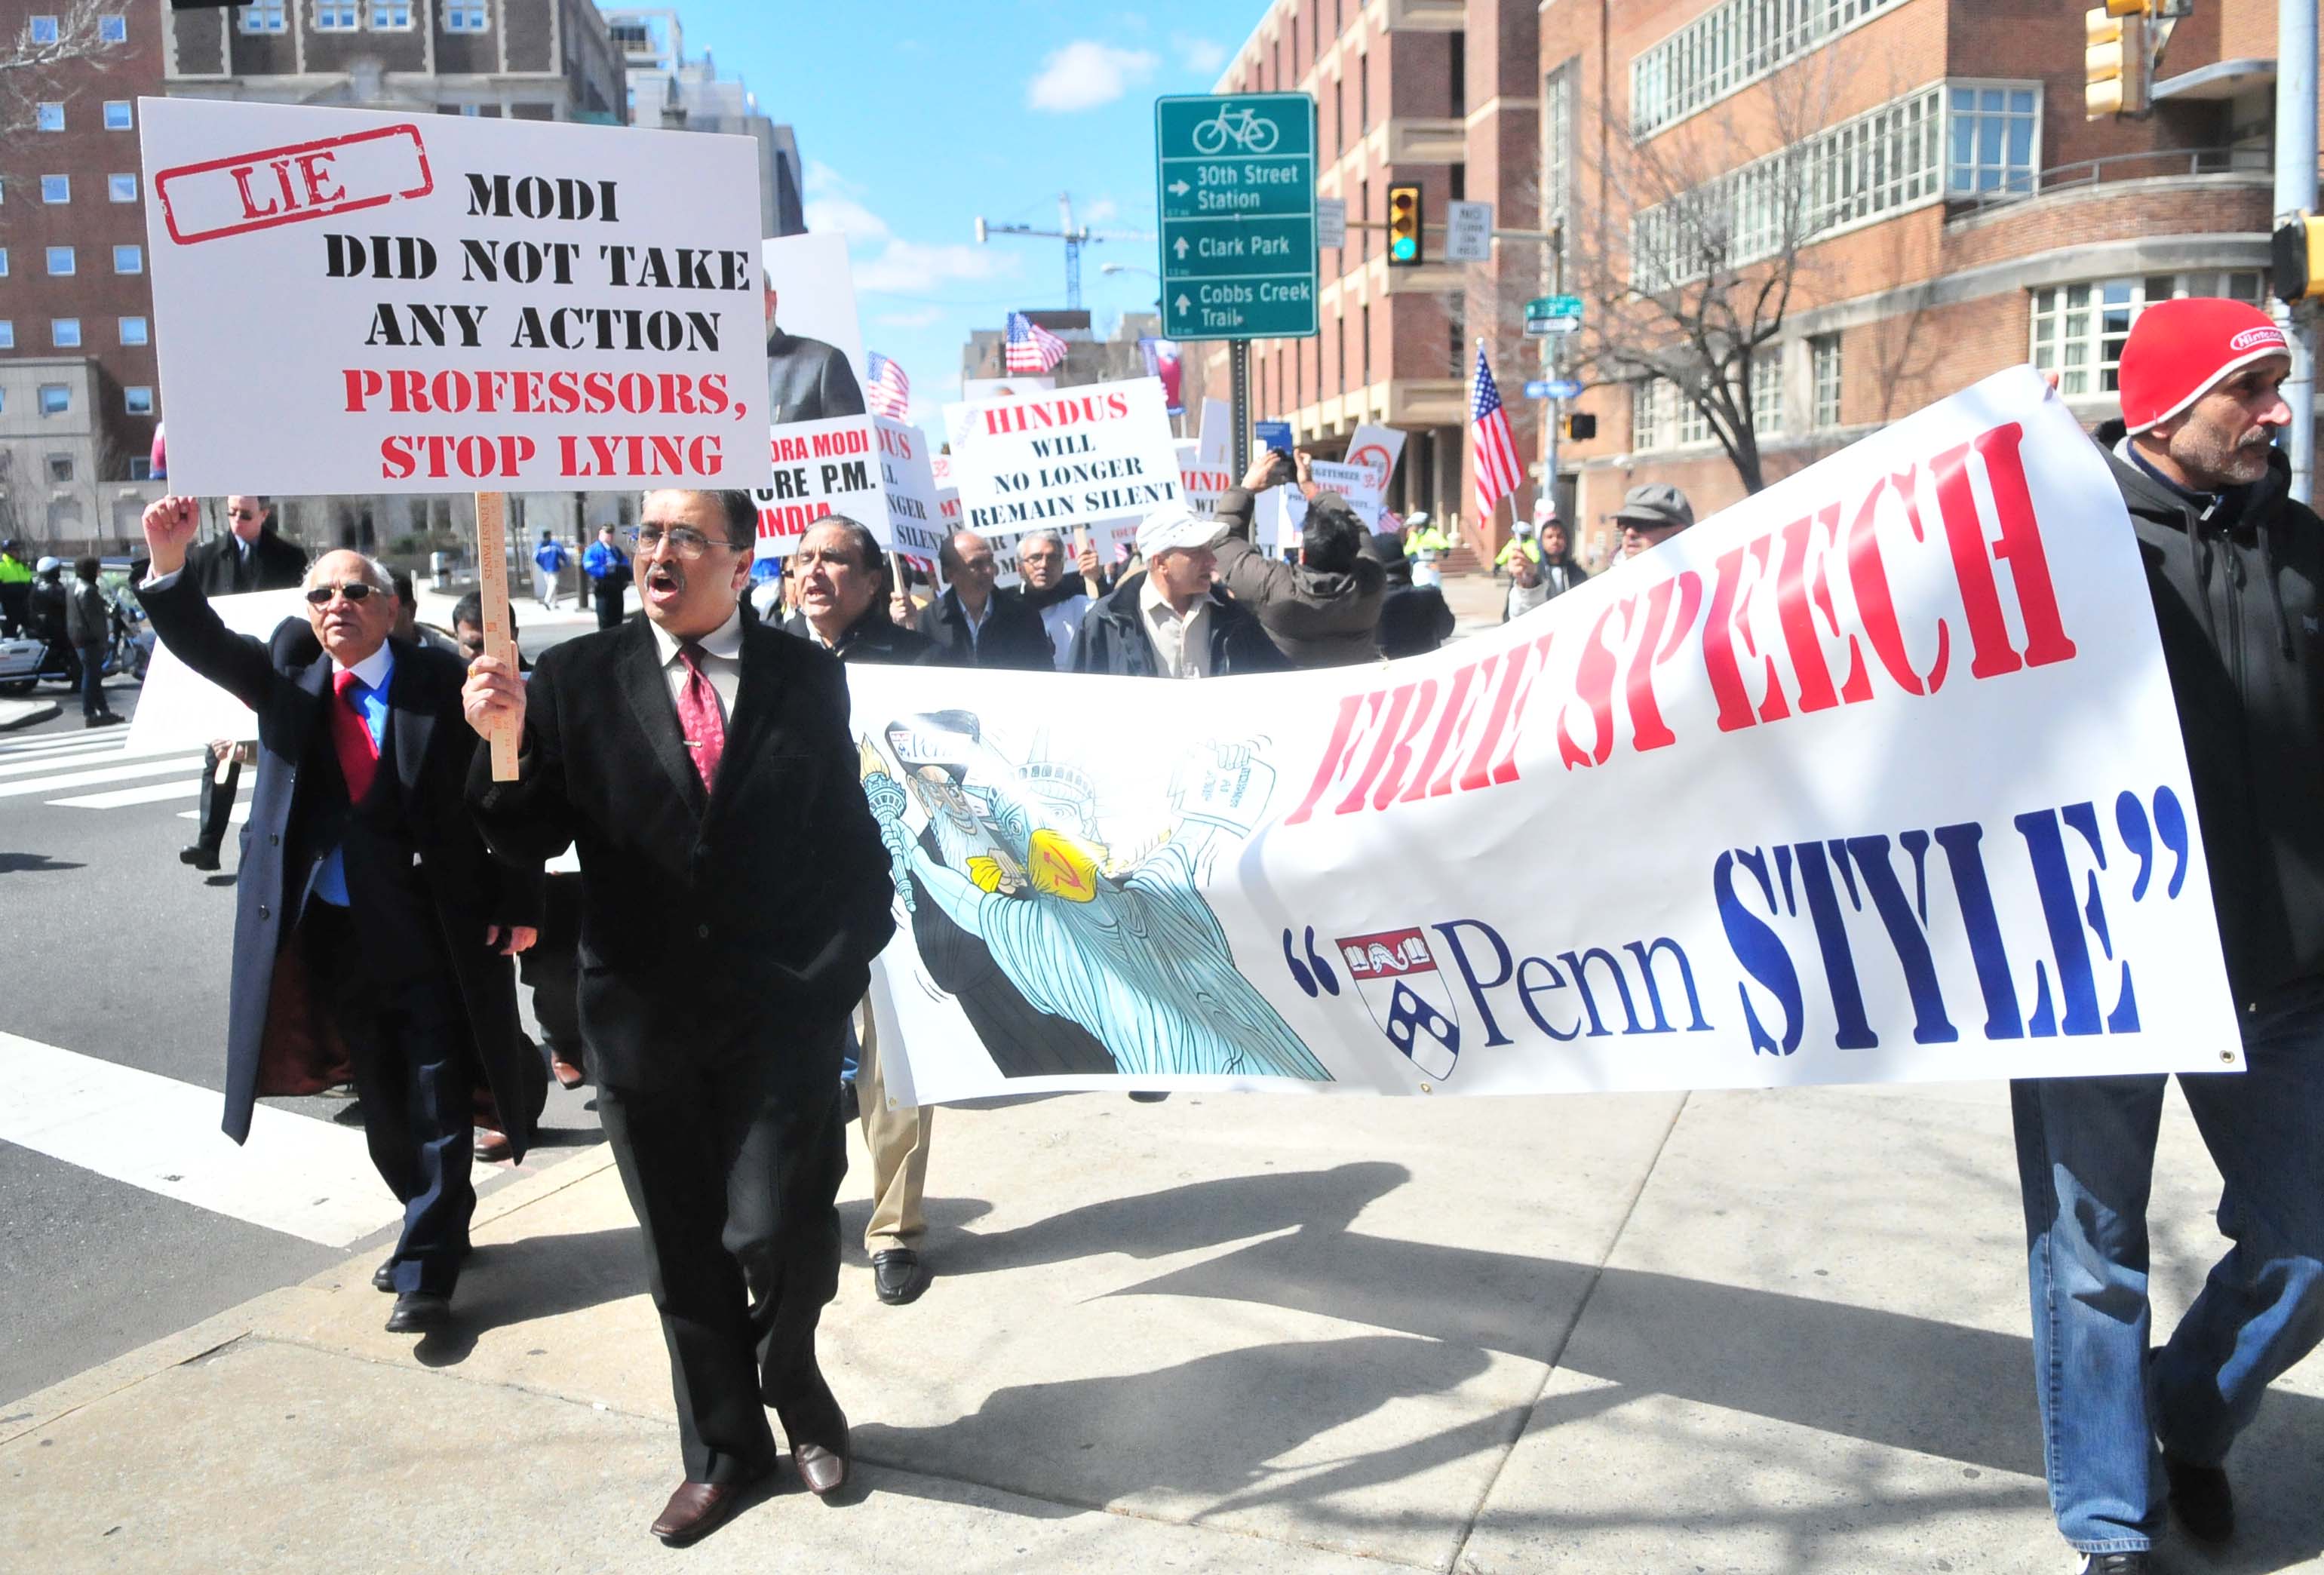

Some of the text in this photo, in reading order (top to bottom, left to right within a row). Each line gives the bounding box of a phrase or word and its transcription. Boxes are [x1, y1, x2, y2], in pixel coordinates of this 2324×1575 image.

[231, 152, 345, 220] LIE
[1197, 164, 1298, 186] 30th Street
[465, 173, 619, 222] MODI
[1198, 189, 1260, 211] Station
[324, 235, 750, 291] DID NOT TAKE
[1199, 235, 1290, 257] Clark Park
[1200, 281, 1311, 303] Cobbs Creek
[364, 303, 721, 352] ANY ACTION
[1201, 308, 1237, 327] Trail
[342, 370, 747, 421] PROFESSORS,
[984, 392, 1128, 435] HINDUS
[381, 435, 723, 479] STOP LYING
[812, 428, 869, 459] MODI
[1031, 433, 1096, 459] WILL
[821, 460, 876, 494] P.M.
[994, 456, 1144, 494] NO LONGER
[970, 480, 1176, 527] REMAIN SILENT
[896, 524, 942, 550] SILEN
[483, 543, 493, 580] PAINTS
[1285, 422, 2076, 824] FREE SPEECH
[1432, 918, 1715, 1048] Penn
